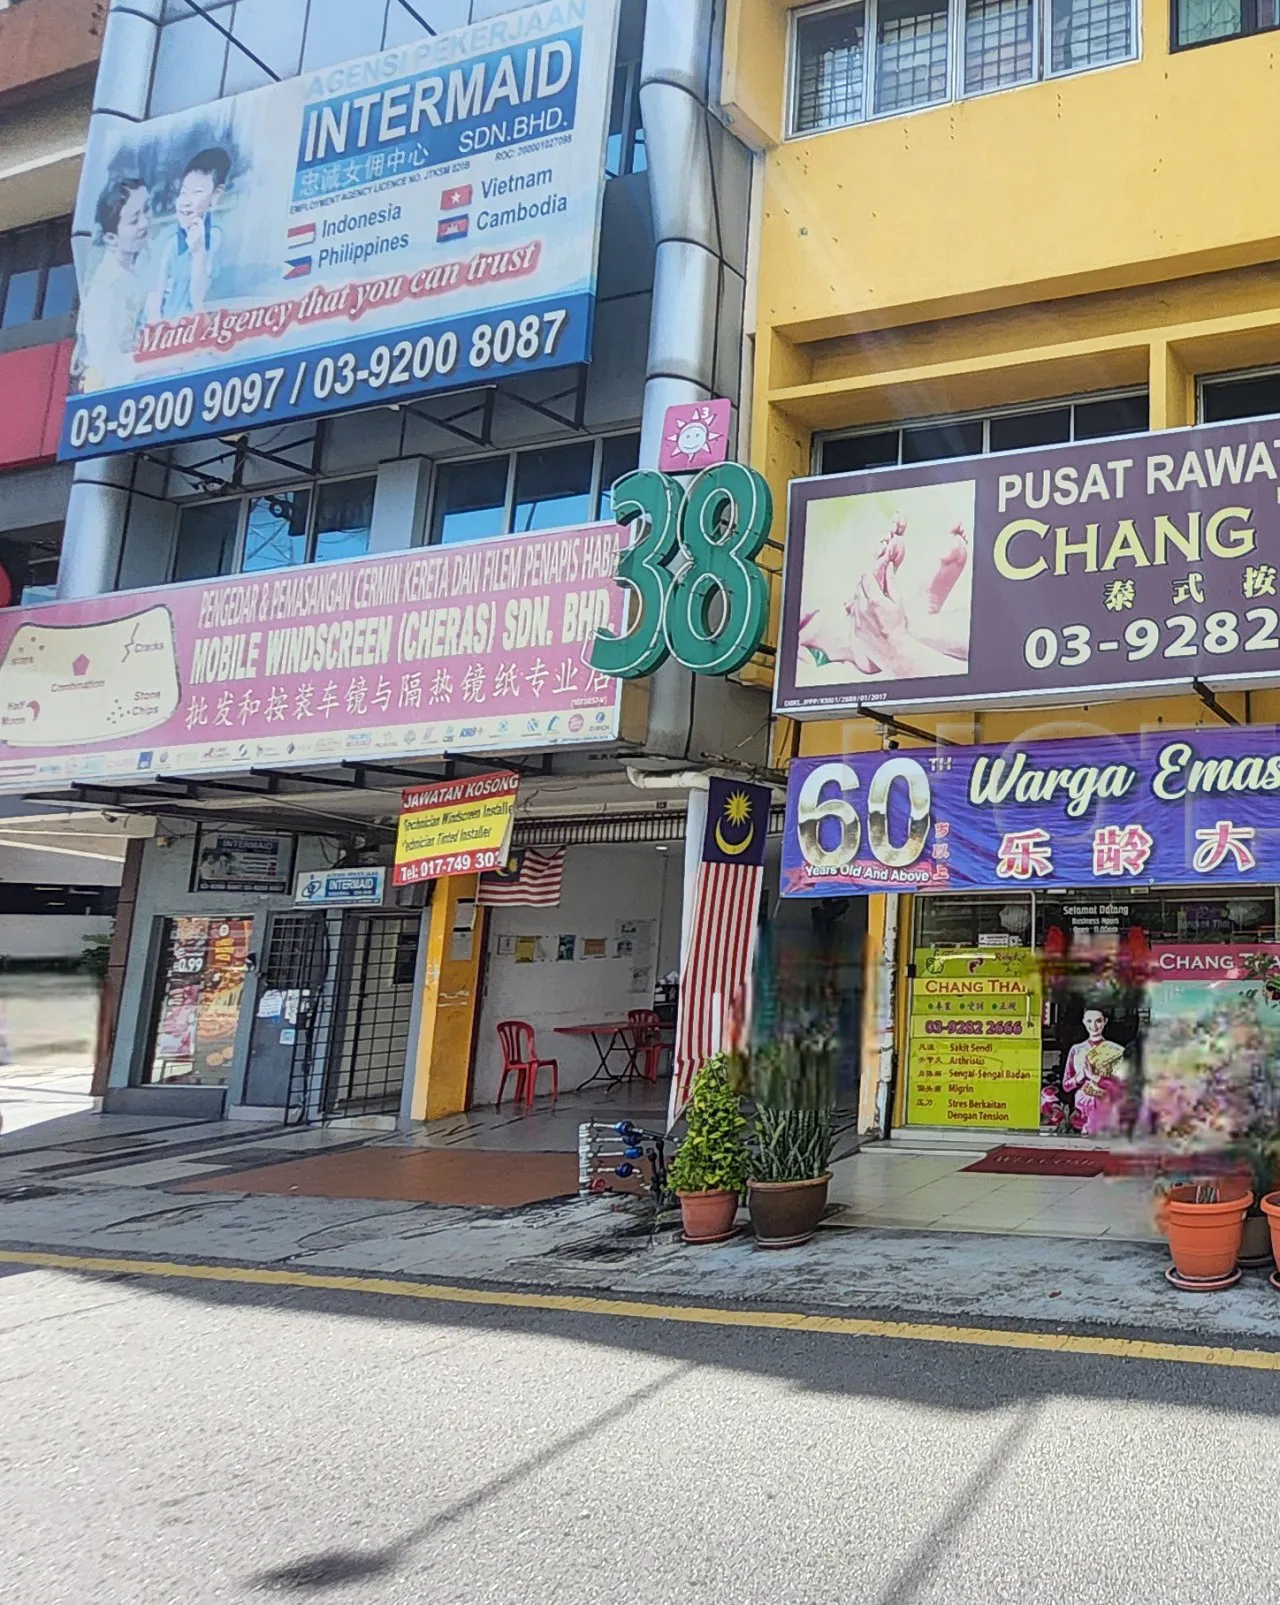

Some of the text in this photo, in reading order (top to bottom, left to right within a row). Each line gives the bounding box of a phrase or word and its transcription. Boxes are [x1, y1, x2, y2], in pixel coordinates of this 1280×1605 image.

[304, 1, 587, 99] AGENSI PEKERJAAN
[304, 40, 573, 162] INTERMAID
[458, 107, 568, 153] SDN.BHD.
[480, 168, 552, 199] Vietnam
[321, 203, 402, 239] Indonesia
[476, 194, 568, 231] Cambodia
[317, 231, 409, 268] Philippines
[138, 243, 537, 353] Maid Agency that you can trust
[70, 386, 194, 449] 03-9200
[202, 368, 283, 424] 9097
[312, 330, 459, 399] 03-9200
[468, 308, 568, 370] 8087
[997, 458, 1134, 514] PUSAT
[993, 505, 1258, 581] CHANG
[198, 584, 260, 629] PENGEDAR
[259, 582, 270, 621] &
[270, 571, 350, 621] PEMASANGAN
[354, 562, 401, 610] CERMIN
[401, 556, 449, 602] KERETA
[450, 551, 482, 597] DAN
[483, 545, 522, 592] FILEM
[524, 537, 580, 588] PENAPIS
[580, 461, 773, 680] 38
[190, 631, 262, 685] MOBILE
[265, 615, 394, 677] WINDSCREEN
[397, 601, 497, 664] (CHERAS)
[502, 596, 554, 650] SDN.
[403, 774, 520, 809] JAWATAN KOSONG
[969, 752, 1138, 818] Warga
[797, 756, 953, 868] 60 TH
[328, 878, 374, 891] INTERMAID
[401, 865, 419, 882] Tel:
[420, 853, 472, 878] 017-749
[805, 864, 930, 881] Years Old And Above
[1063, 904, 1129, 916] Selamat Datang
[1159, 952, 1235, 970] CHANG
[925, 979, 984, 994] CHANG
[924, 1020, 1023, 1035] 03-9282 2666
[950, 1043, 993, 1052] Sakit Sendi
[948, 1069, 1004, 1081] Sengal-Sengal
[1006, 1070, 1031, 1080] Badan
[948, 1083, 974, 1095] Migrin
[947, 1111, 1009, 1122] Dengan Tension
[948, 1099, 1007, 1109] Stres Berkaitan
